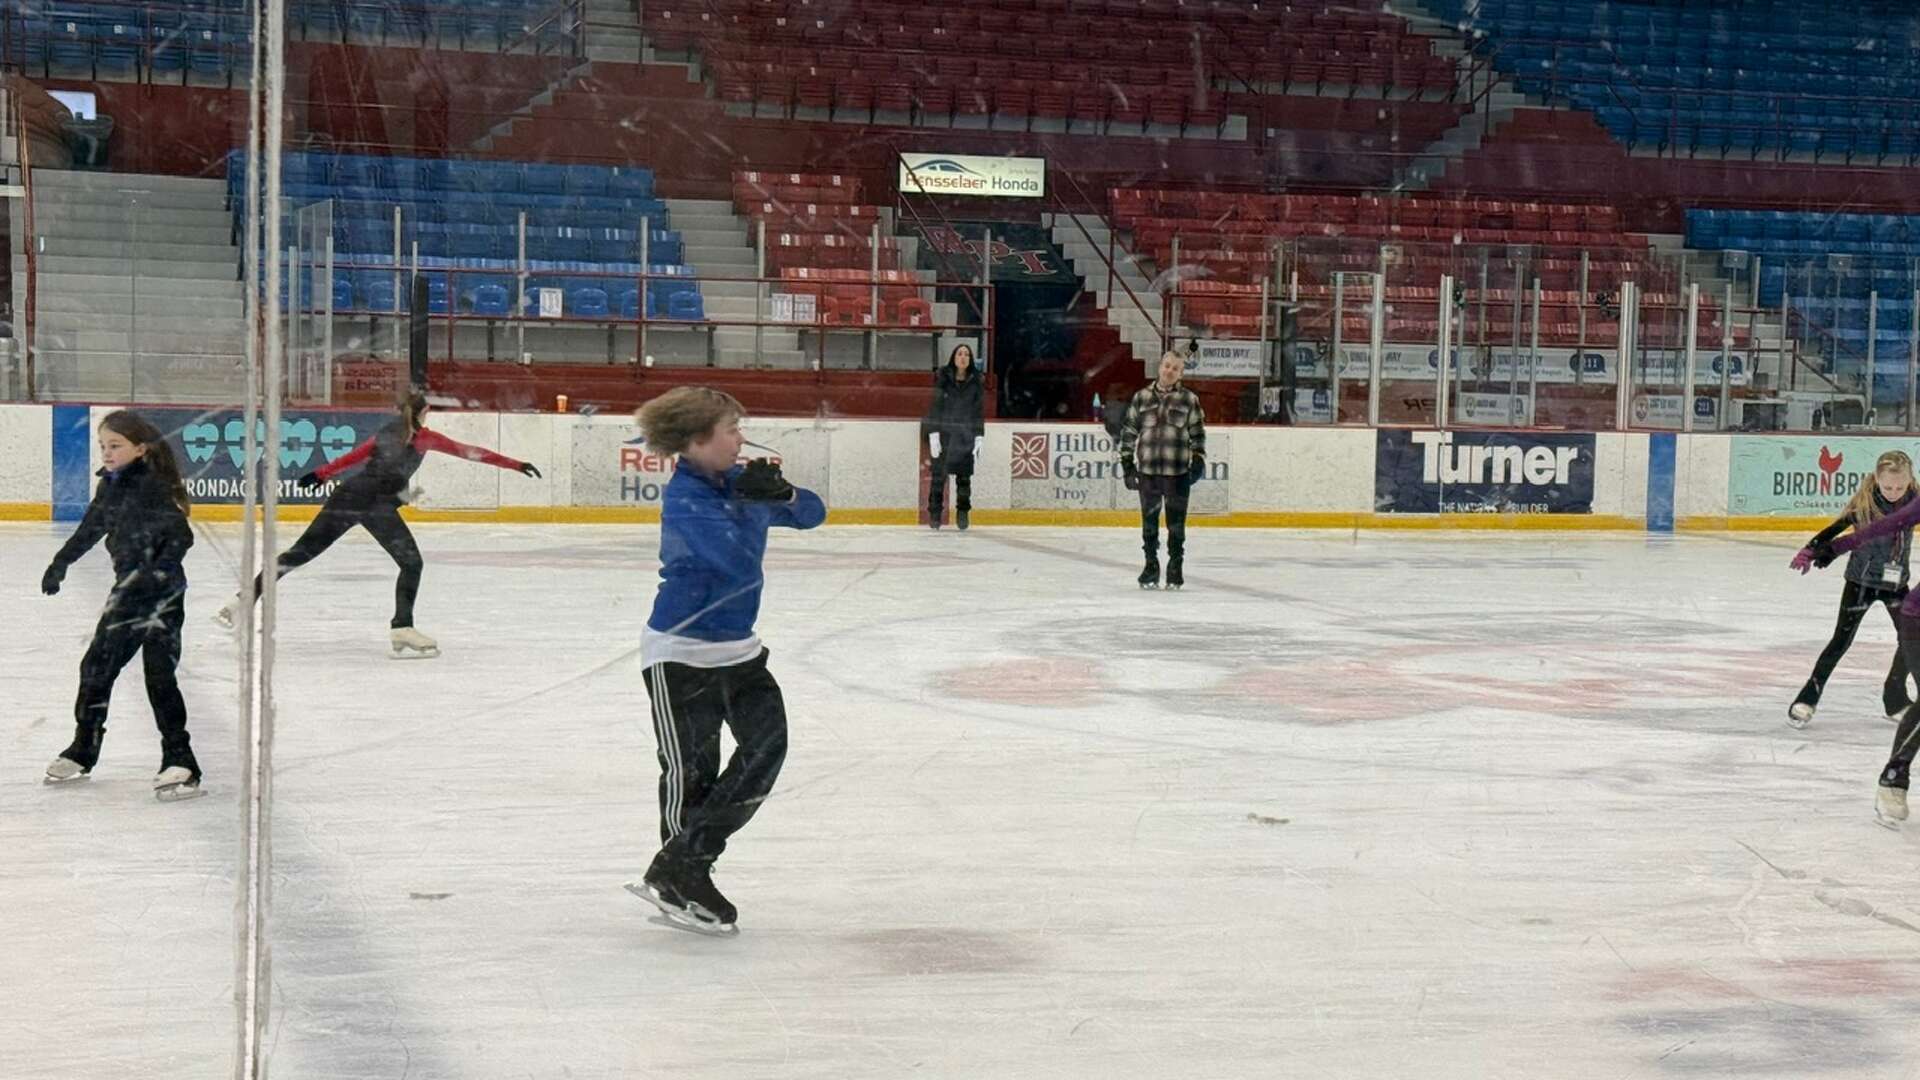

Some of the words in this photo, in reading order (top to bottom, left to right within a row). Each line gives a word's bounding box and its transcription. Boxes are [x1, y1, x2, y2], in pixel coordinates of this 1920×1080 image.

[905, 173, 987, 190] Rensselaer
[991, 175, 1039, 191] Honda
[1055, 432, 1117, 453] Hilto
[1054, 453, 1123, 480] Gar
[1411, 431, 1579, 486] Turner
[1773, 471, 1864, 496] BIRDNBR
[1053, 487, 1089, 504] Troy
[1438, 502, 1456, 513] THE
